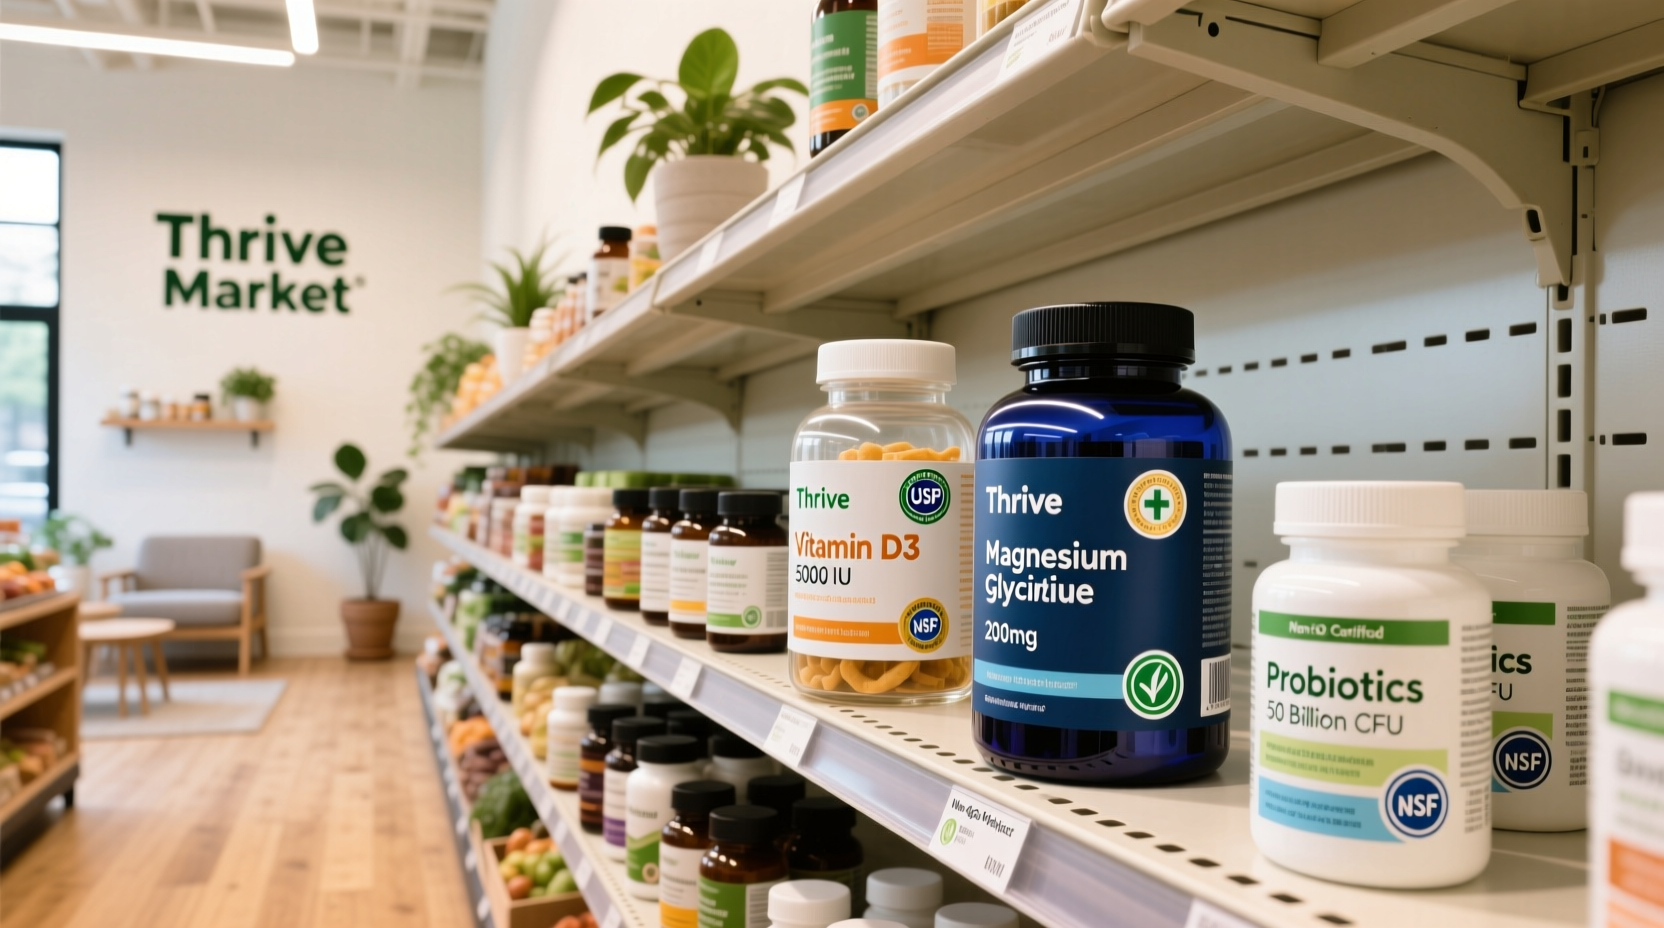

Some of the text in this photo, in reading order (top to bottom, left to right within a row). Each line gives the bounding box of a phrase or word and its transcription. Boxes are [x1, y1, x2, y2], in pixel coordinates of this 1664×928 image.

[156, 213, 347, 266] Thrive
[165, 269, 350, 313] Market
[797, 486, 850, 509] Thrive
[911, 487, 941, 505] USP
[986, 485, 1063, 515] Thrive
[795, 531, 920, 561] Vitamin D3
[986, 539, 1127, 575] Magnesium
[795, 564, 852, 585] 5000 IU
[913, 617, 939, 635] NSF
[984, 620, 1038, 652] 200mg
[1267, 661, 1423, 703] Probiotics
[1266, 700, 1404, 735] 50 Billion CFU
[1504, 752, 1542, 771] NSF
[1398, 793, 1440, 817] NSF
